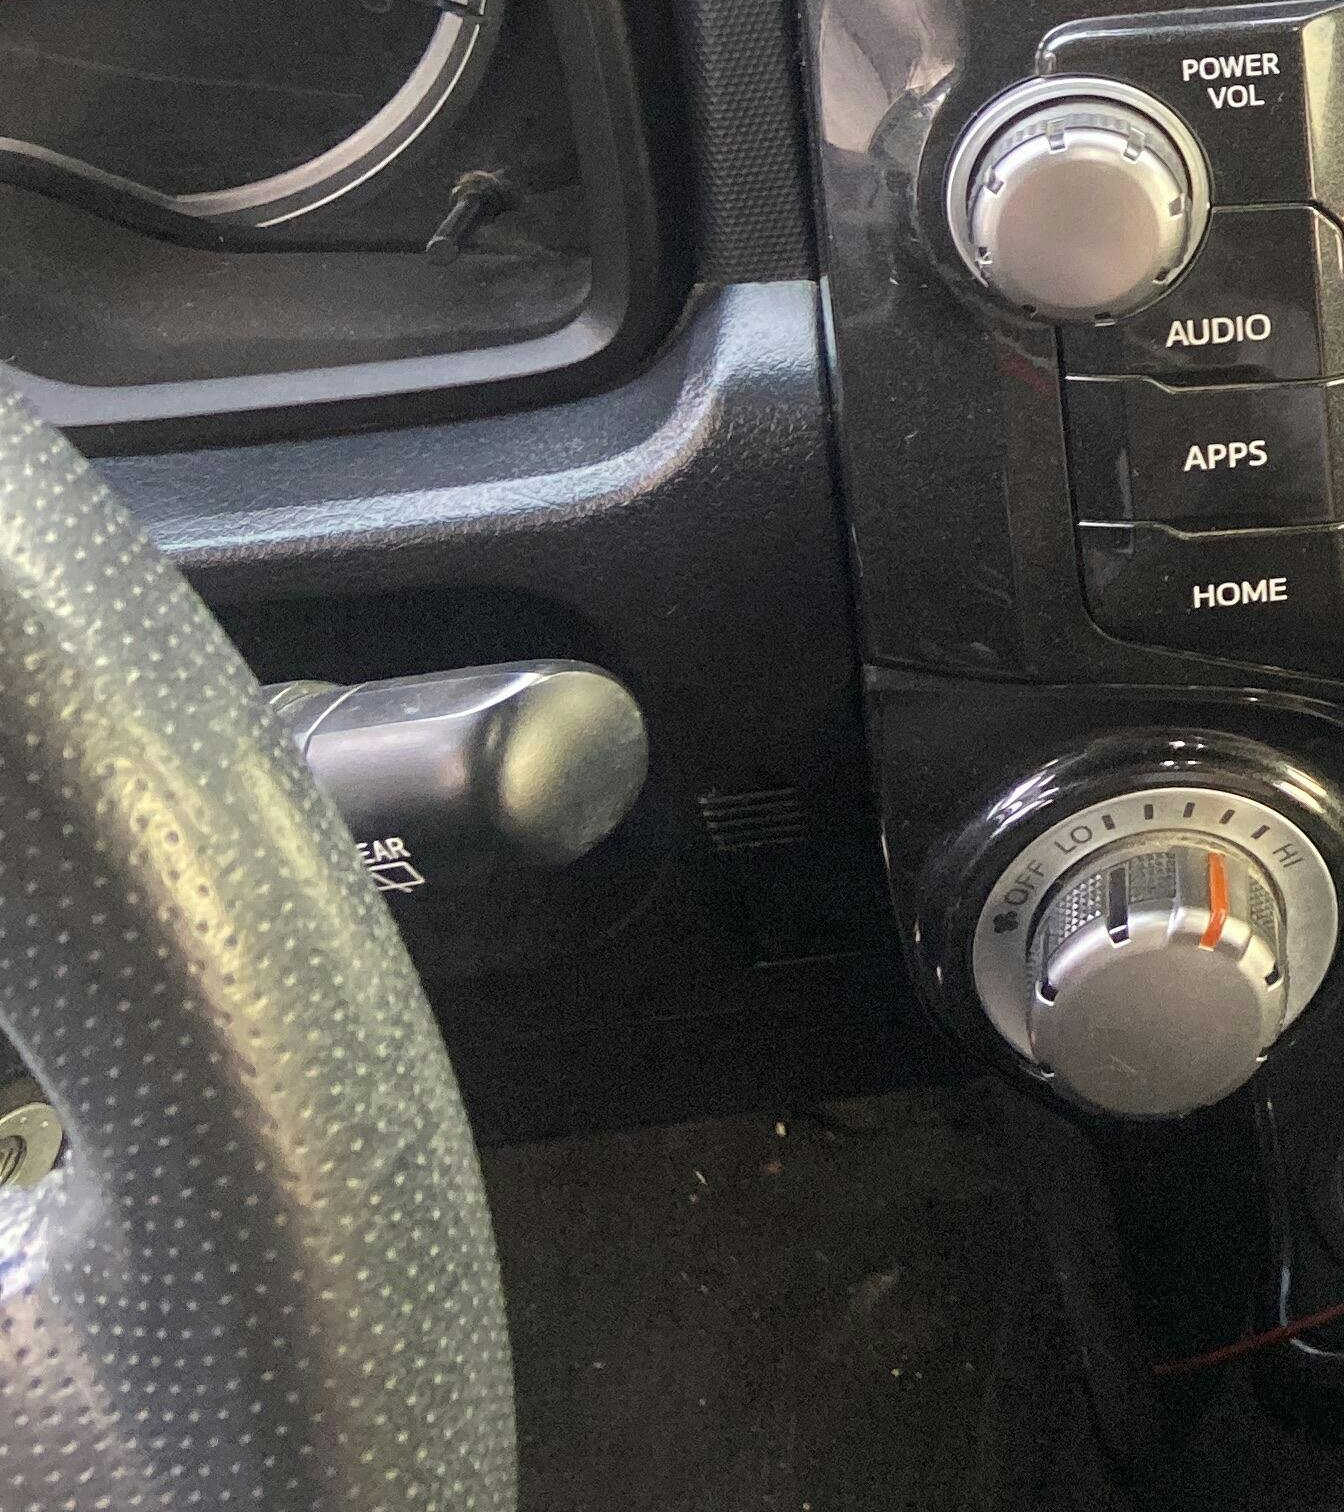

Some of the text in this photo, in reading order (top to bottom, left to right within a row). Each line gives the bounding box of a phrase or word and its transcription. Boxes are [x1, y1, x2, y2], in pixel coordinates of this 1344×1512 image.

[1182, 52, 1280, 82] POWER
[1207, 83, 1265, 110] VOL
[1165, 313, 1272, 348] AUDIO
[1184, 440, 1268, 472] APPS
[1193, 577, 1288, 608] HOME
[356, 837, 411, 864] EAR
[1054, 825, 1093, 856] LO
[1273, 843, 1306, 869] HI
[1004, 860, 1046, 908] OFF
